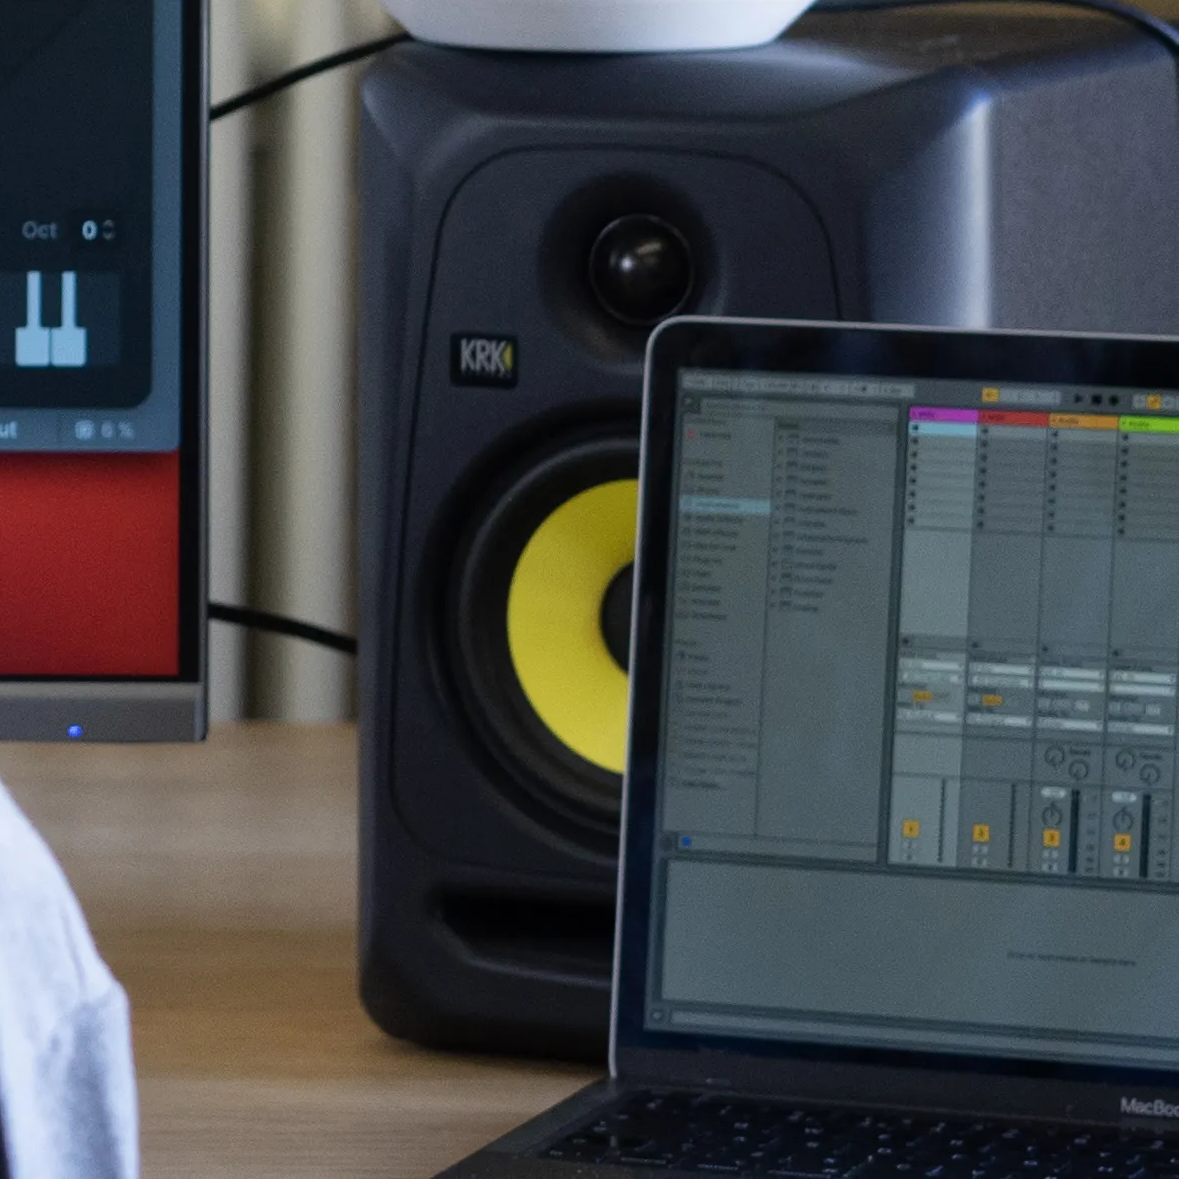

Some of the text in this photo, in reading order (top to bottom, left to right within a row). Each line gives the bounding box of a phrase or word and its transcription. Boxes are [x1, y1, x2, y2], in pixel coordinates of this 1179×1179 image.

[22, 220, 97, 240] Oct 0
[461, 338, 507, 374] KRK
